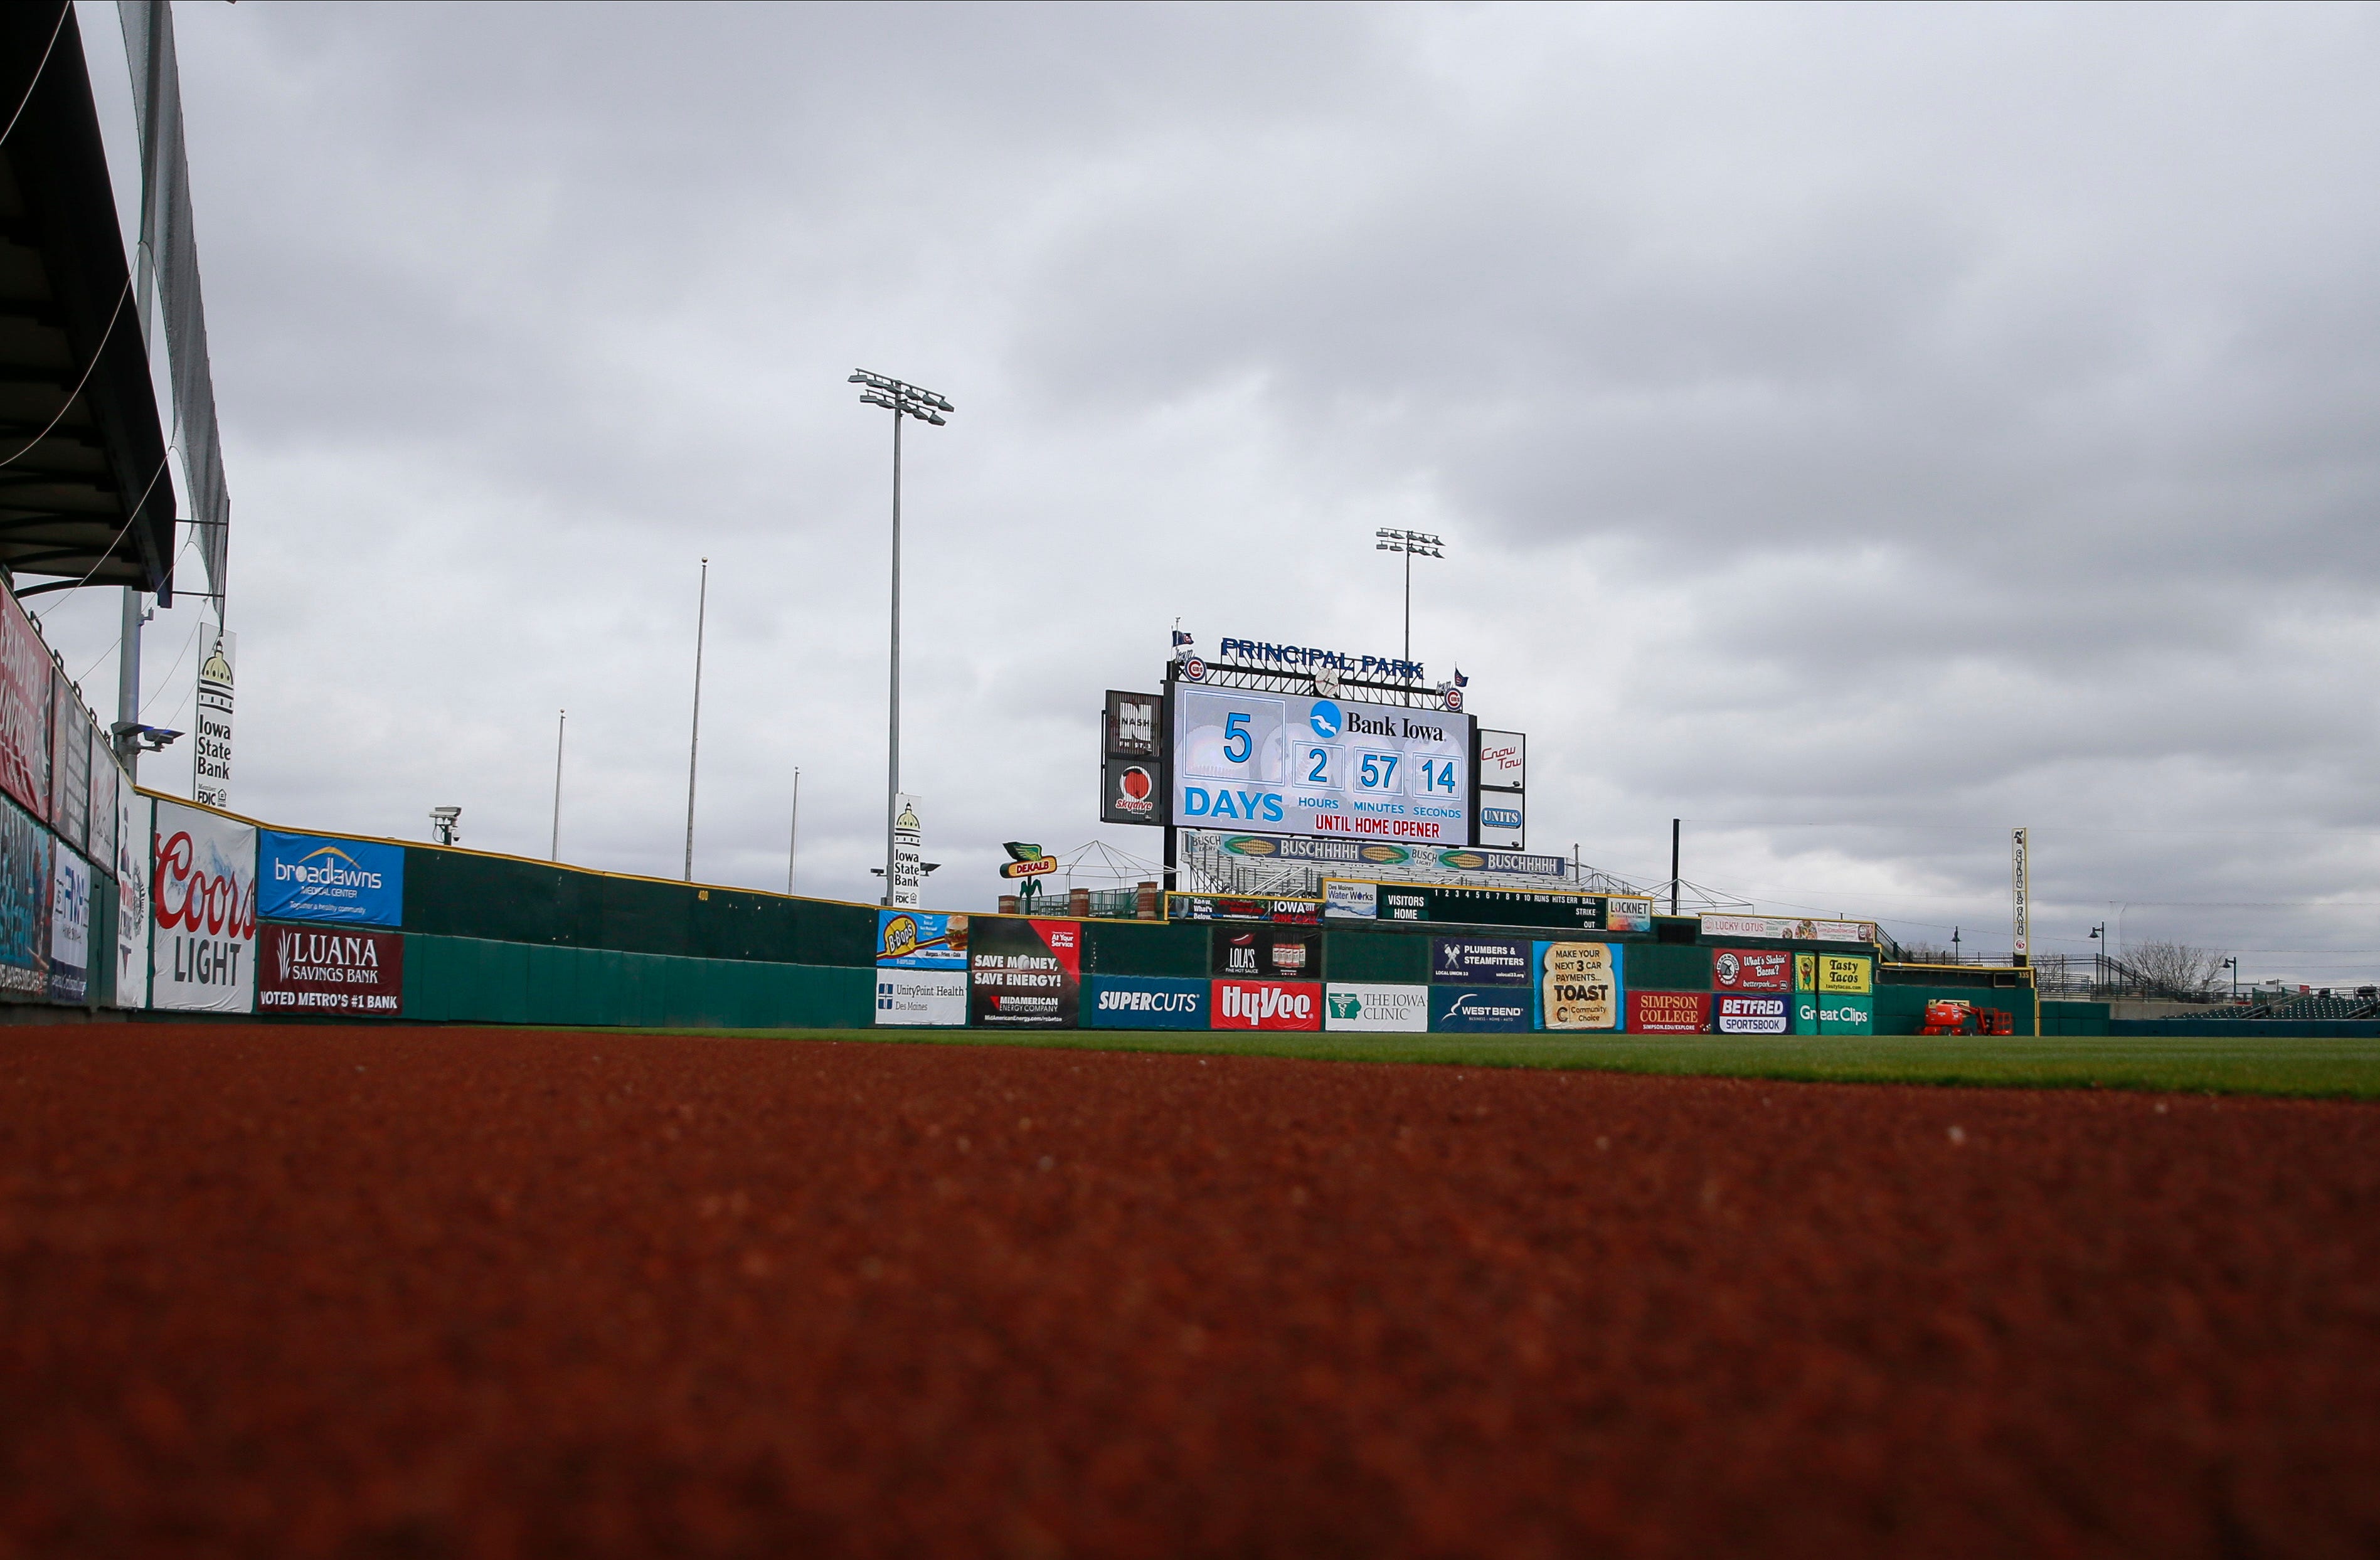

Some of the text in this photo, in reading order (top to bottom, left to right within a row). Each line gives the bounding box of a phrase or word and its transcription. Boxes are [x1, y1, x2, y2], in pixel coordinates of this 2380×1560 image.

[1221, 637, 1424, 679] PRINCIPAL PARK
[199, 714, 230, 740] Iowa
[1122, 717, 1150, 726] NASH
[1347, 711, 1443, 741] Bank Iowa
[1224, 712, 1252, 763] 5
[198, 736, 231, 760] State
[198, 756, 230, 780] Bank
[1309, 748, 1327, 782] 2
[1497, 757, 1522, 770] Tow
[1361, 754, 1398, 788] 57
[1421, 760, 1455, 793] 14
[198, 791, 216, 805] FDIC
[1184, 787, 1283, 822] DAYS
[1299, 797, 1339, 809] HOURS
[1354, 801, 1404, 814] MINUTES
[1413, 807, 1460, 819] SECONDS
[1484, 810, 1518, 823] UNITS
[1316, 815, 1439, 837] UNTIL HOME OPENER
[895, 849, 918, 862] Iowa
[1412, 849, 1437, 862] BUSCH
[275, 857, 381, 888] broadlawns
[895, 862, 919, 875] State
[1017, 861, 1049, 873] DEKALB
[154, 831, 256, 940] Coors
[895, 874, 918, 887] Bank
[300, 886, 358, 898] MEDICAL CENTER
[1329, 890, 1373, 901] Water Works
[895, 895, 909, 903] FDIC
[1388, 895, 1424, 906] VISITORS
[1274, 901, 1305, 913] IOWA
[1576, 908, 1596, 916] STRIKE
[1611, 901, 1648, 914] LOCKNET
[1394, 909, 1417, 920] HOME
[1715, 921, 1738, 931] LUCKY
[1741, 921, 1764, 931] LOTUS
[294, 933, 378, 967] LUANA
[1465, 945, 1507, 955] PLUMBERS
[175, 936, 242, 986] LIGHT
[975, 955, 1003, 967] SAVE
[1230, 948, 1255, 968] LOLA'S
[1464, 957, 1524, 965] STEAMFITTERS
[1744, 956, 1765, 966] What's
[1576, 960, 1584, 972] 3
[1755, 965, 1779, 977] Bacon?
[1829, 959, 1858, 974] Tasty
[293, 965, 378, 984] SAVINGS BANK
[975, 973, 1061, 987] SAVE ENERGY!
[1829, 972, 1858, 983] Tacos
[897, 984, 964, 998] UnityPoint Health
[1553, 985, 1608, 1002] TOAST
[261, 991, 398, 1009] VOTED METRO'S #1 BANK
[895, 1001, 928, 1011] Des Moines
[1000, 996, 1058, 1005] MIDAMERICAN
[1098, 991, 1197, 1012] SUPERCUTS
[1364, 994, 1426, 1007] THE IOWA
[1640, 995, 1698, 1009] SIMPSON
[1722, 999, 1783, 1014] BETFRED
[1364, 1007, 1408, 1021] CLINIC
[1462, 1006, 1521, 1016] WEST BEND
[1640, 1010, 1698, 1022] COLLEGE
[1800, 1005, 1867, 1026] Great Clips
[1726, 1019, 1780, 1029] SPORTSBOOK
